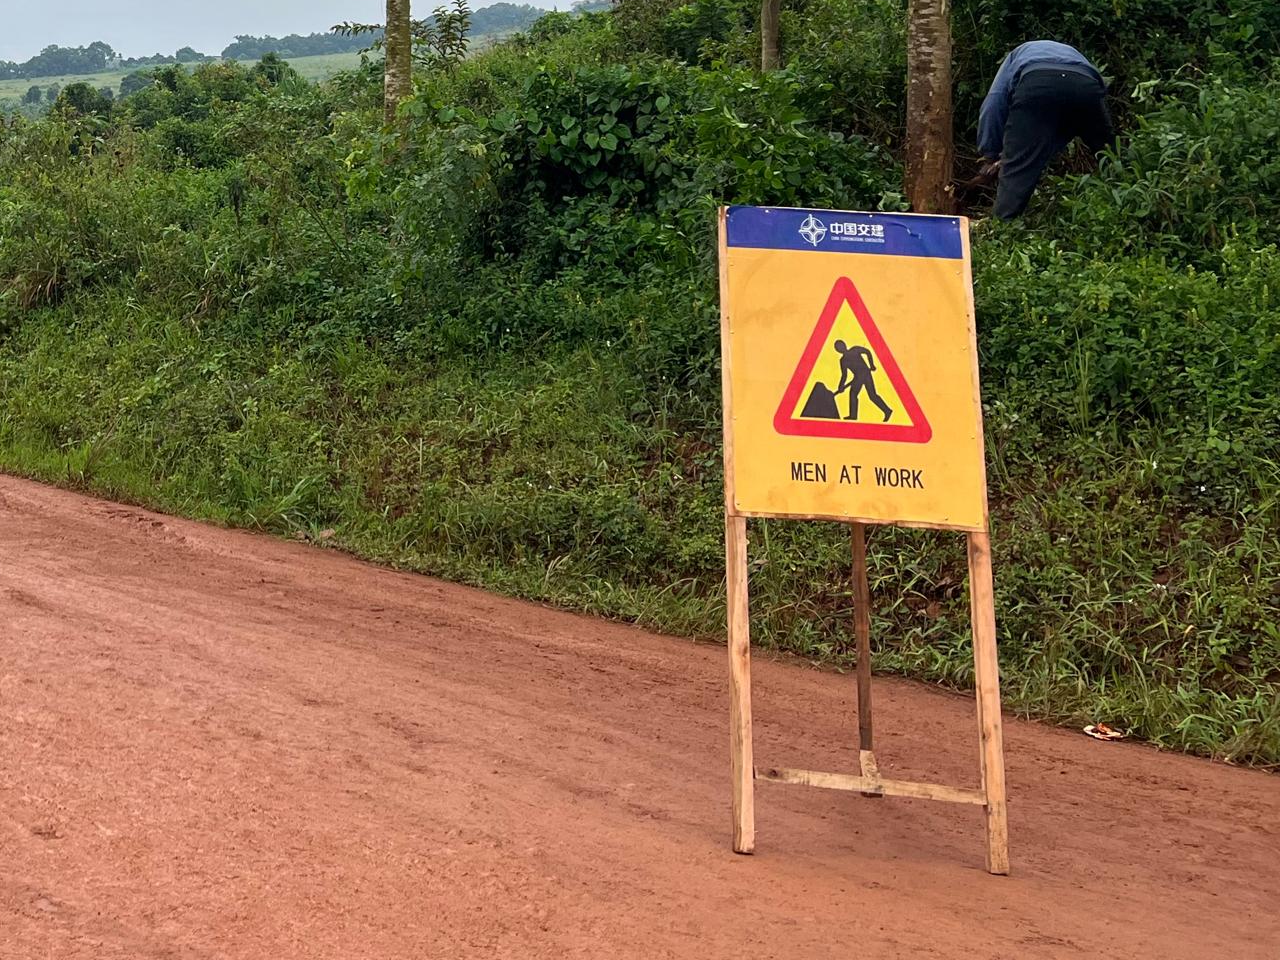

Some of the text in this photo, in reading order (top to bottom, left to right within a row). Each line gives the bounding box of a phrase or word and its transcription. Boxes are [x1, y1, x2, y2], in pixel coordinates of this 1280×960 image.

[829, 222, 885, 237] 中国交建
[791, 461, 924, 489] MEN AT WORK
